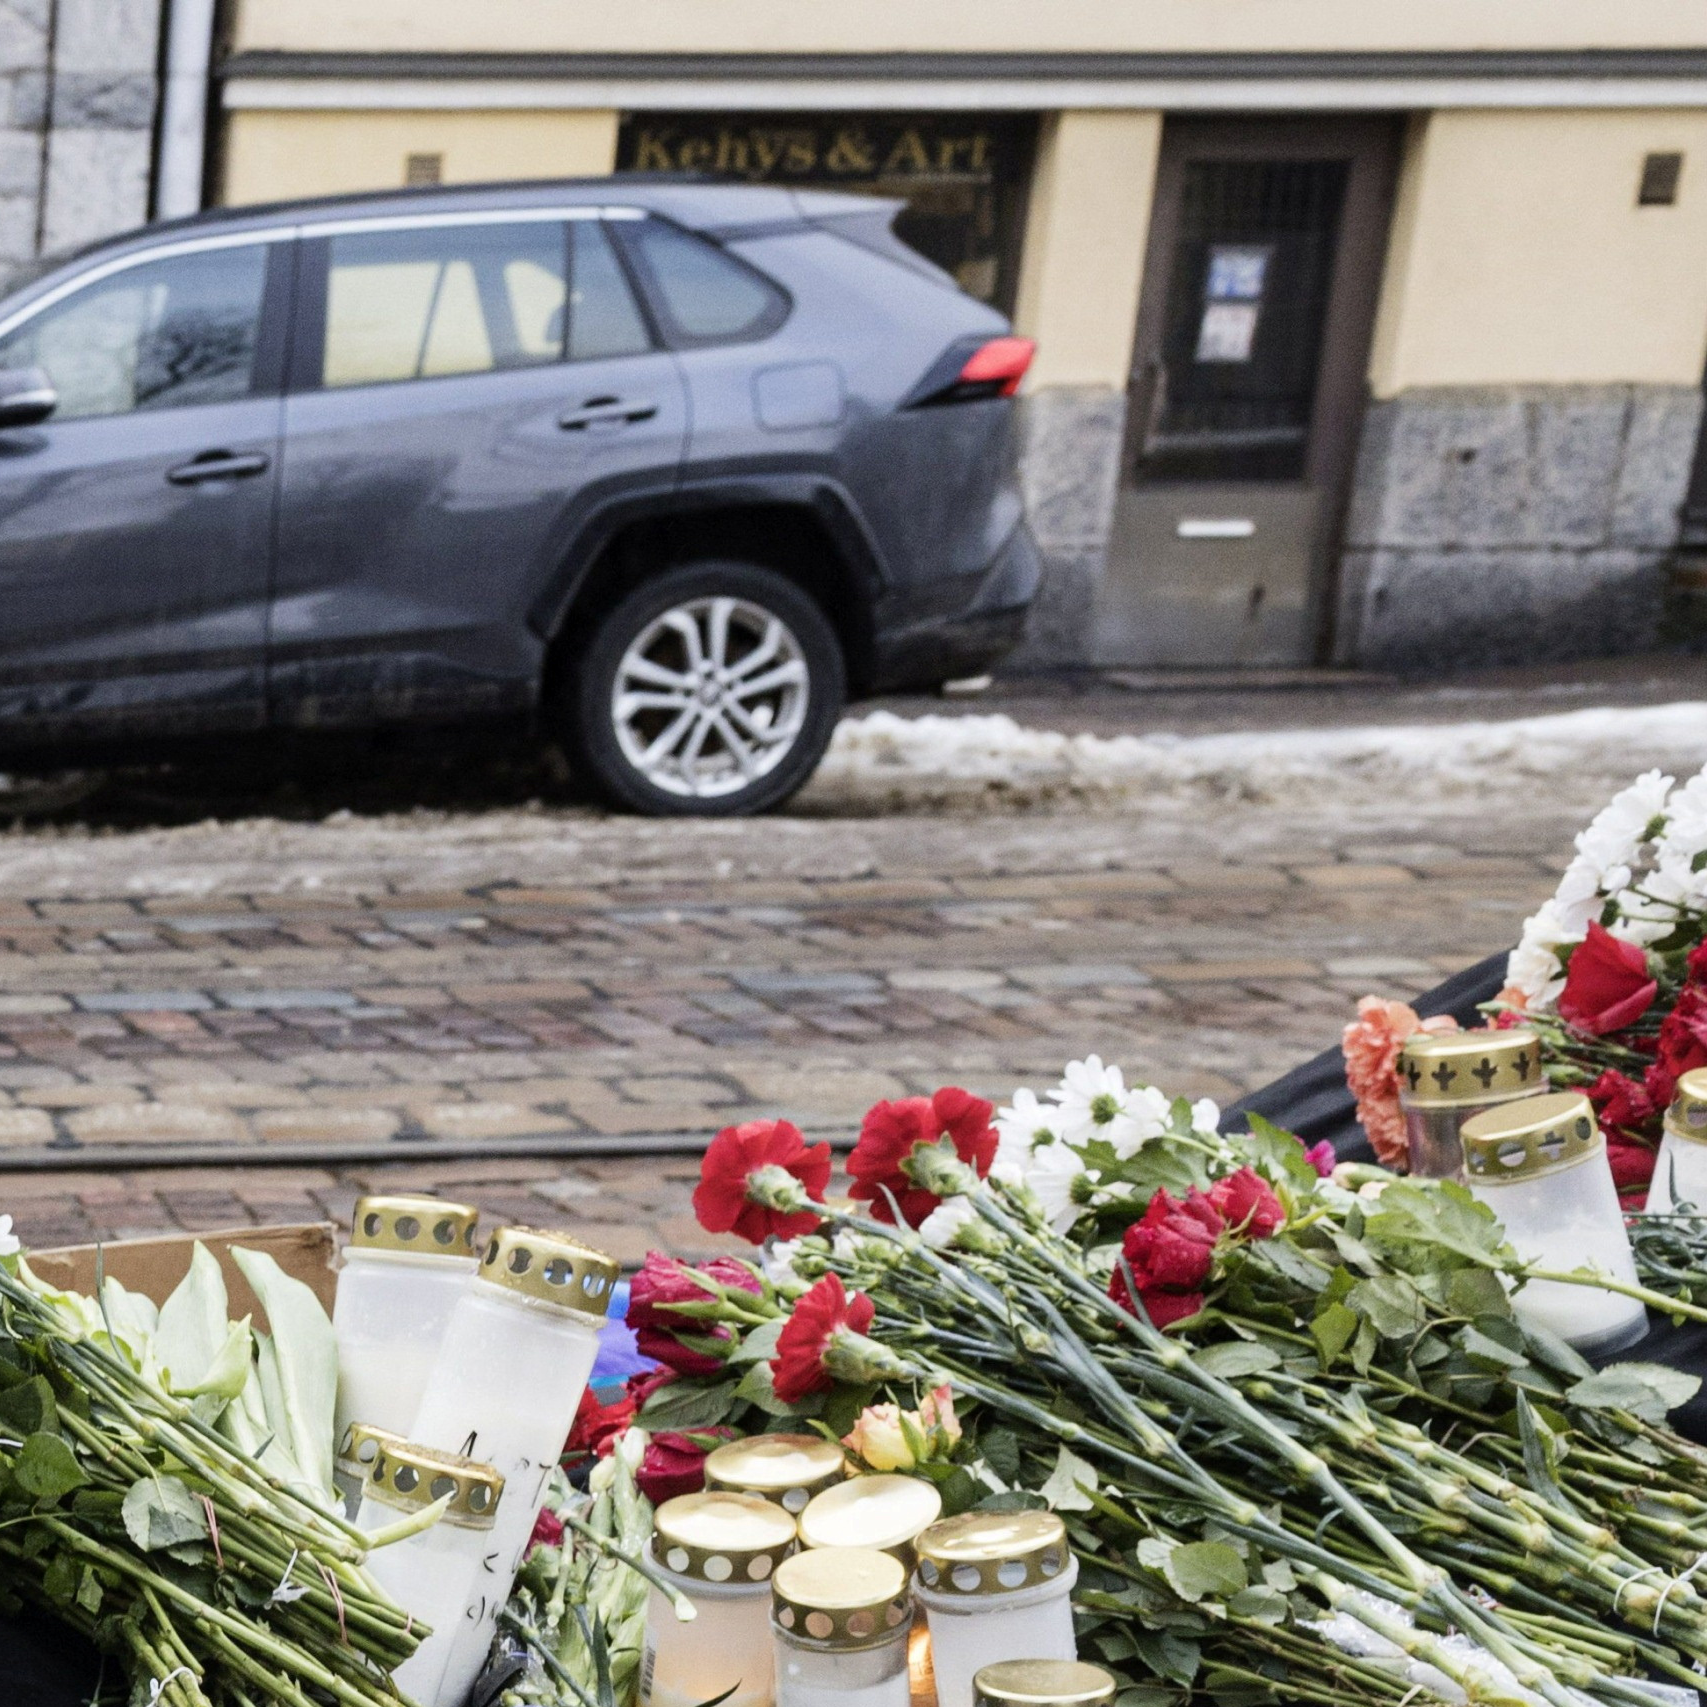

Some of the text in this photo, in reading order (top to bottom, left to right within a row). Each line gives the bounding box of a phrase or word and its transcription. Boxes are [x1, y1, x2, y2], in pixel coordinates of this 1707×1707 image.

[633, 127, 991, 177] Kehys & Art
